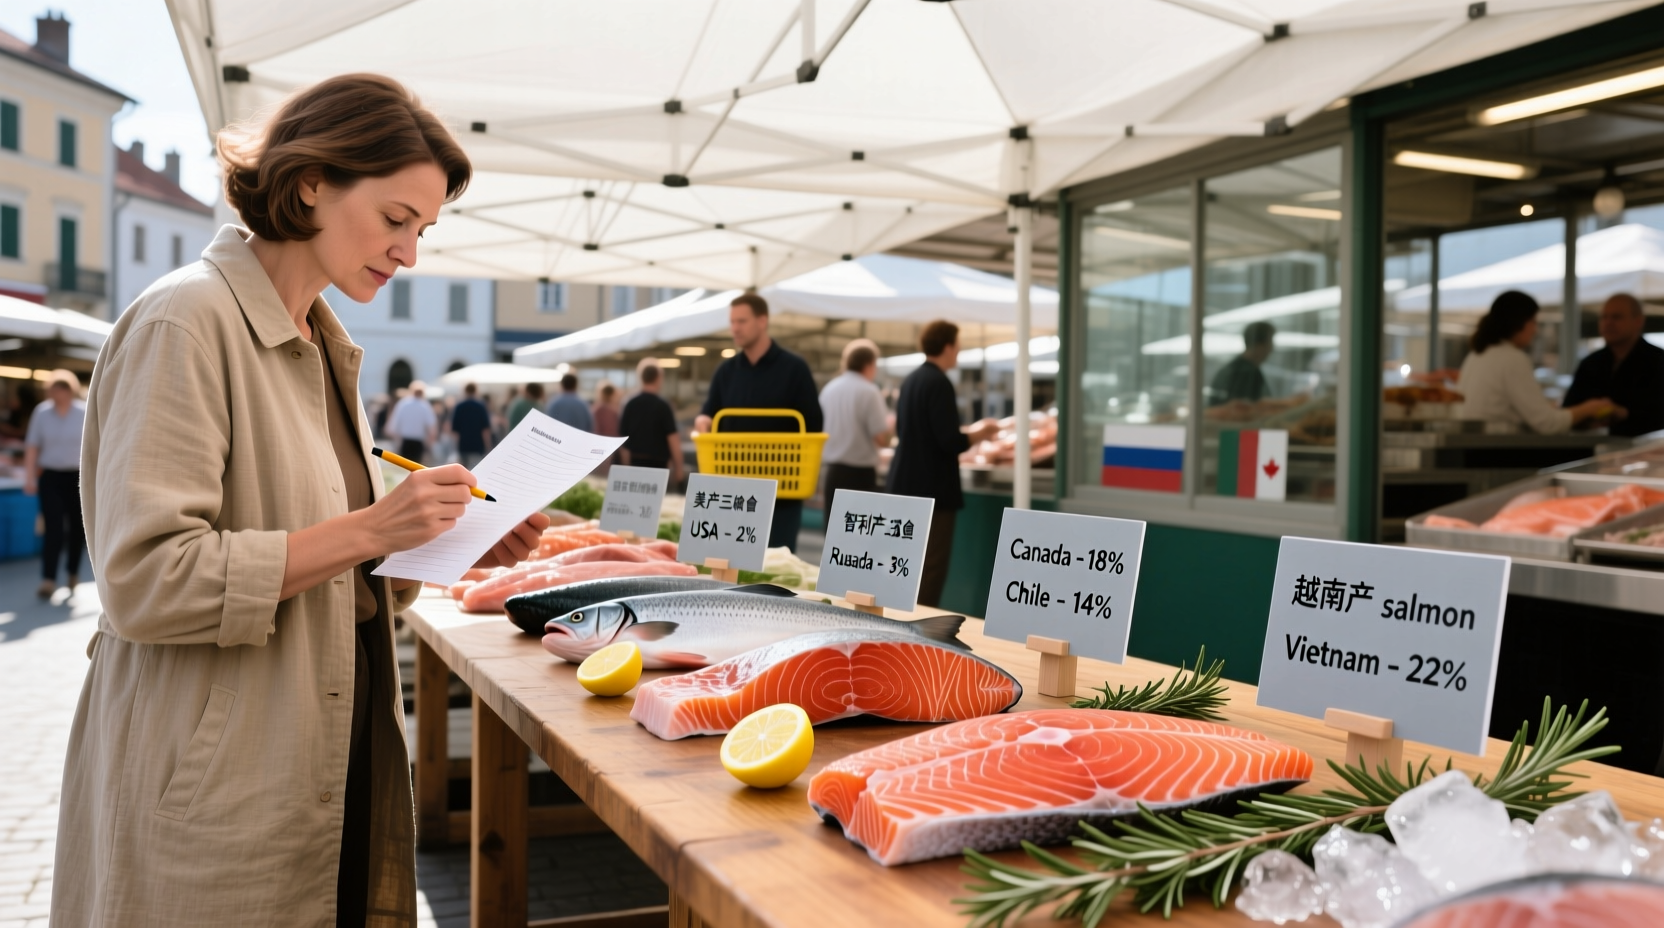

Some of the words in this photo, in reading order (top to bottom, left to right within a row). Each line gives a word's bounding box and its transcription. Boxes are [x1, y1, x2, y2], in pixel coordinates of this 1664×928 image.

[690, 520, 718, 540] USA
[735, 526, 757, 544] 2%
[889, 556, 909, 577] 3%
[1010, 538, 1071, 566] Canada
[1088, 549, 1124, 575] 18%
[1006, 581, 1050, 607] Chile
[1073, 591, 1112, 619] 14%
[1291, 574, 1374, 613] 越南产
[1381, 593, 1476, 630] salmon
[1285, 634, 1380, 675] Vietnam
[1405, 654, 1467, 692] 22%
